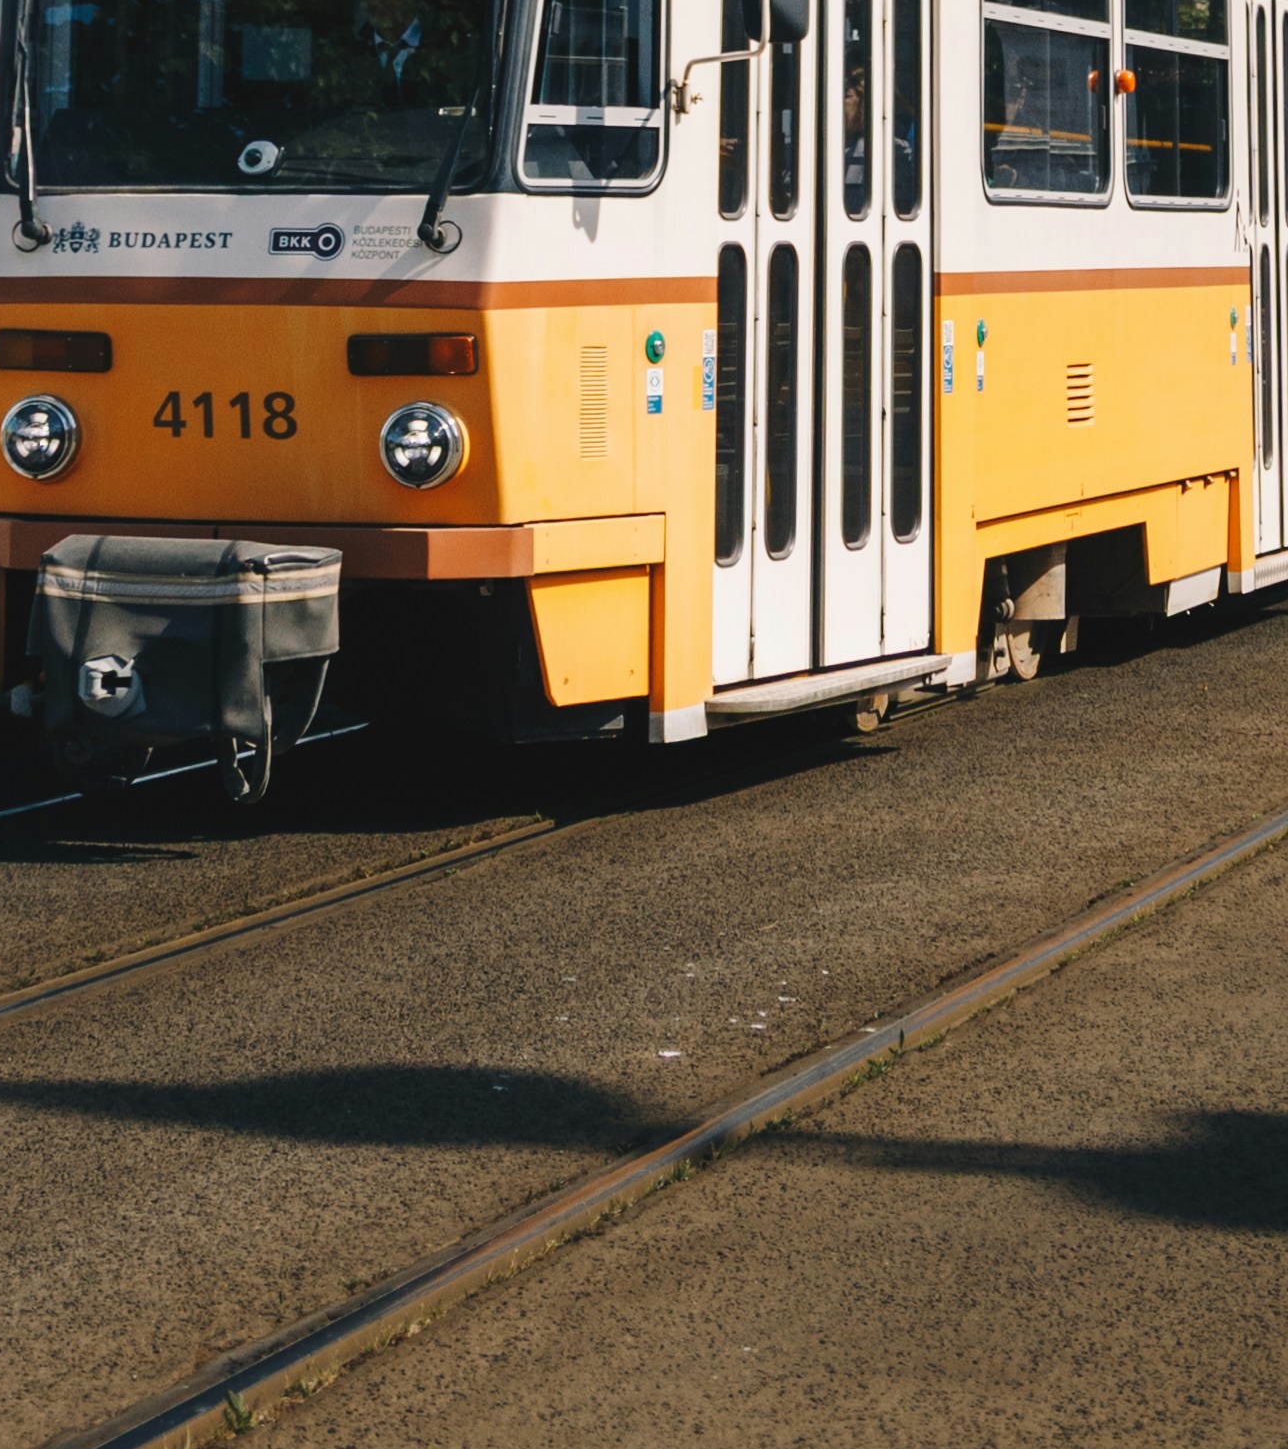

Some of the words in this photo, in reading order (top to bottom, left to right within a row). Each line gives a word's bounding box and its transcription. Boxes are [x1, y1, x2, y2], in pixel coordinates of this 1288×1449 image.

[353, 225, 412, 235] BUDAPESTI
[108, 232, 233, 249] BUDAPEST
[278, 235, 311, 248] BKK
[351, 249, 400, 260] KÖZPONT
[153, 390, 298, 440] 4118
